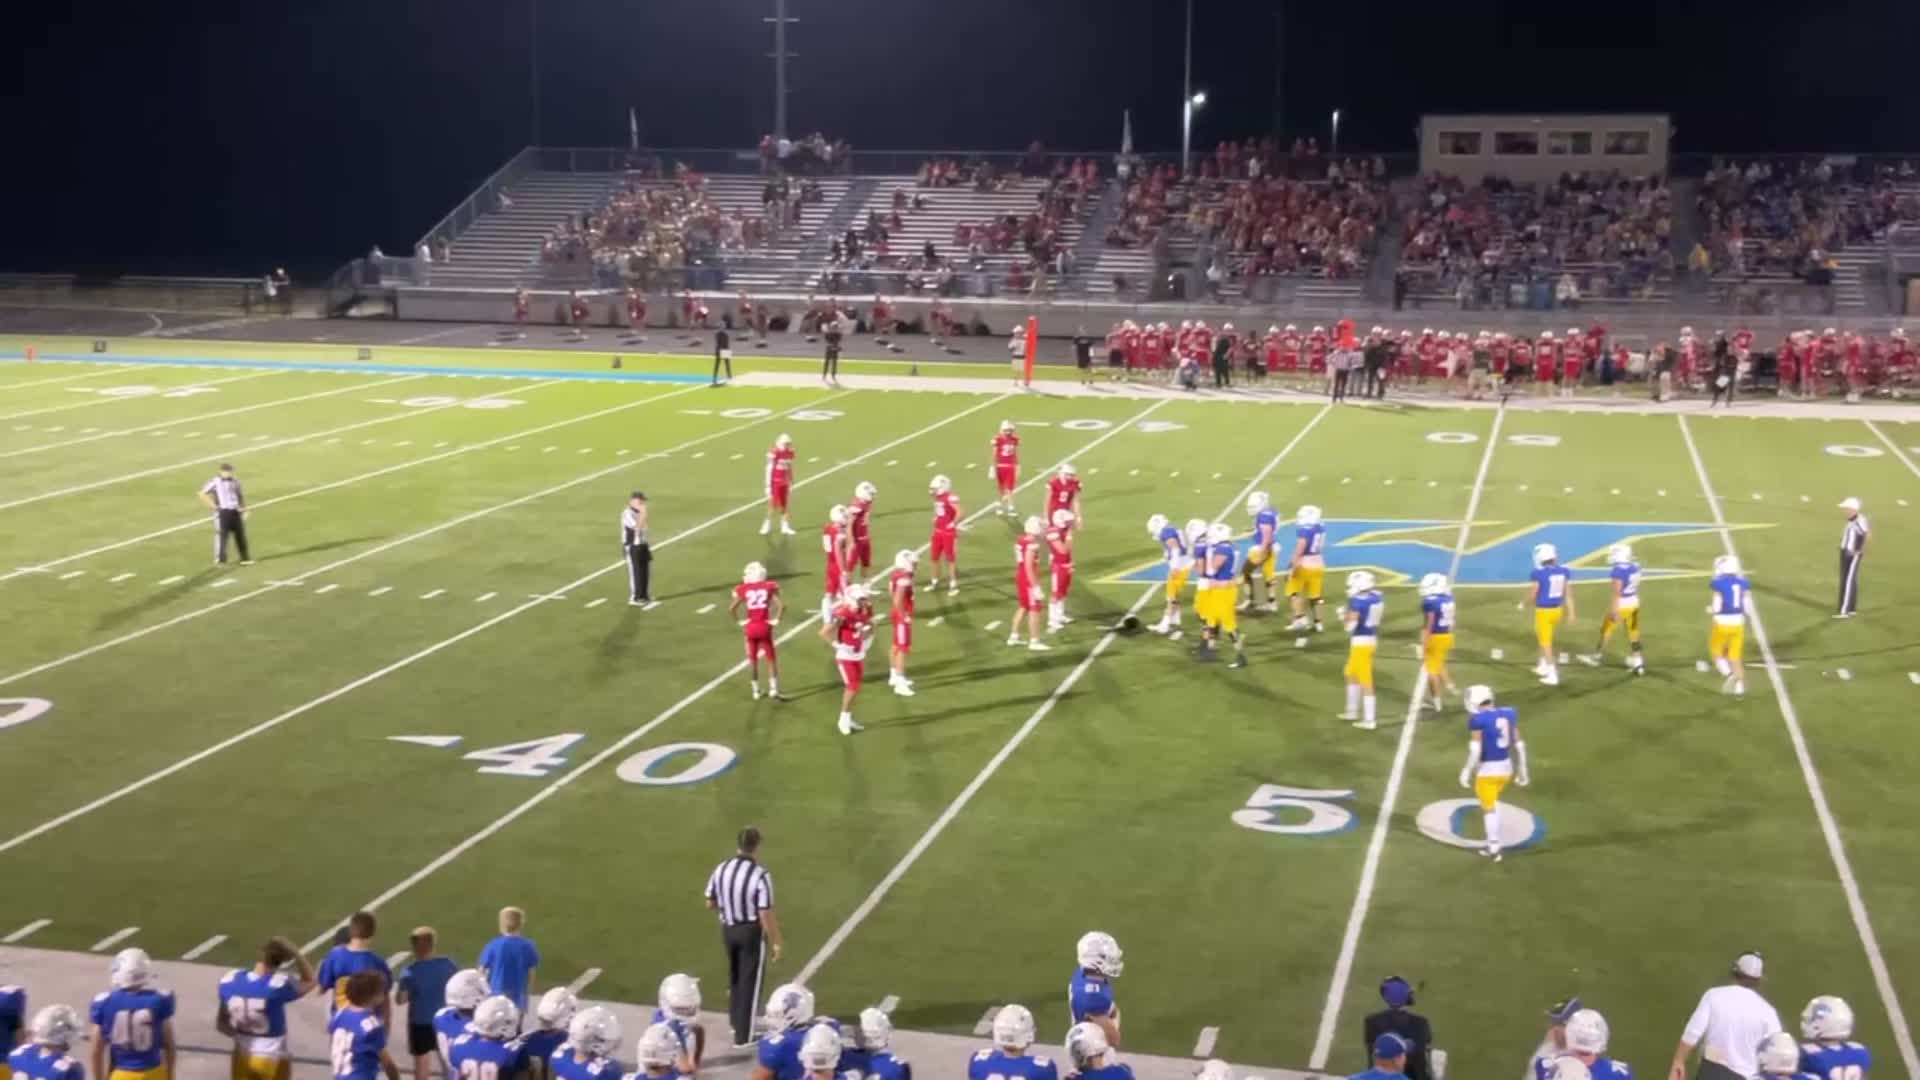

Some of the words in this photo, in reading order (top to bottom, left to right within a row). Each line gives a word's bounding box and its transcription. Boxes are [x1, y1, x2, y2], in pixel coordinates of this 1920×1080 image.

[745, 589, 768, 609] 22
[1731, 583, 1741, 609] 1
[1495, 717, 1510, 749] 3
[111, 1009, 153, 1052] 46
